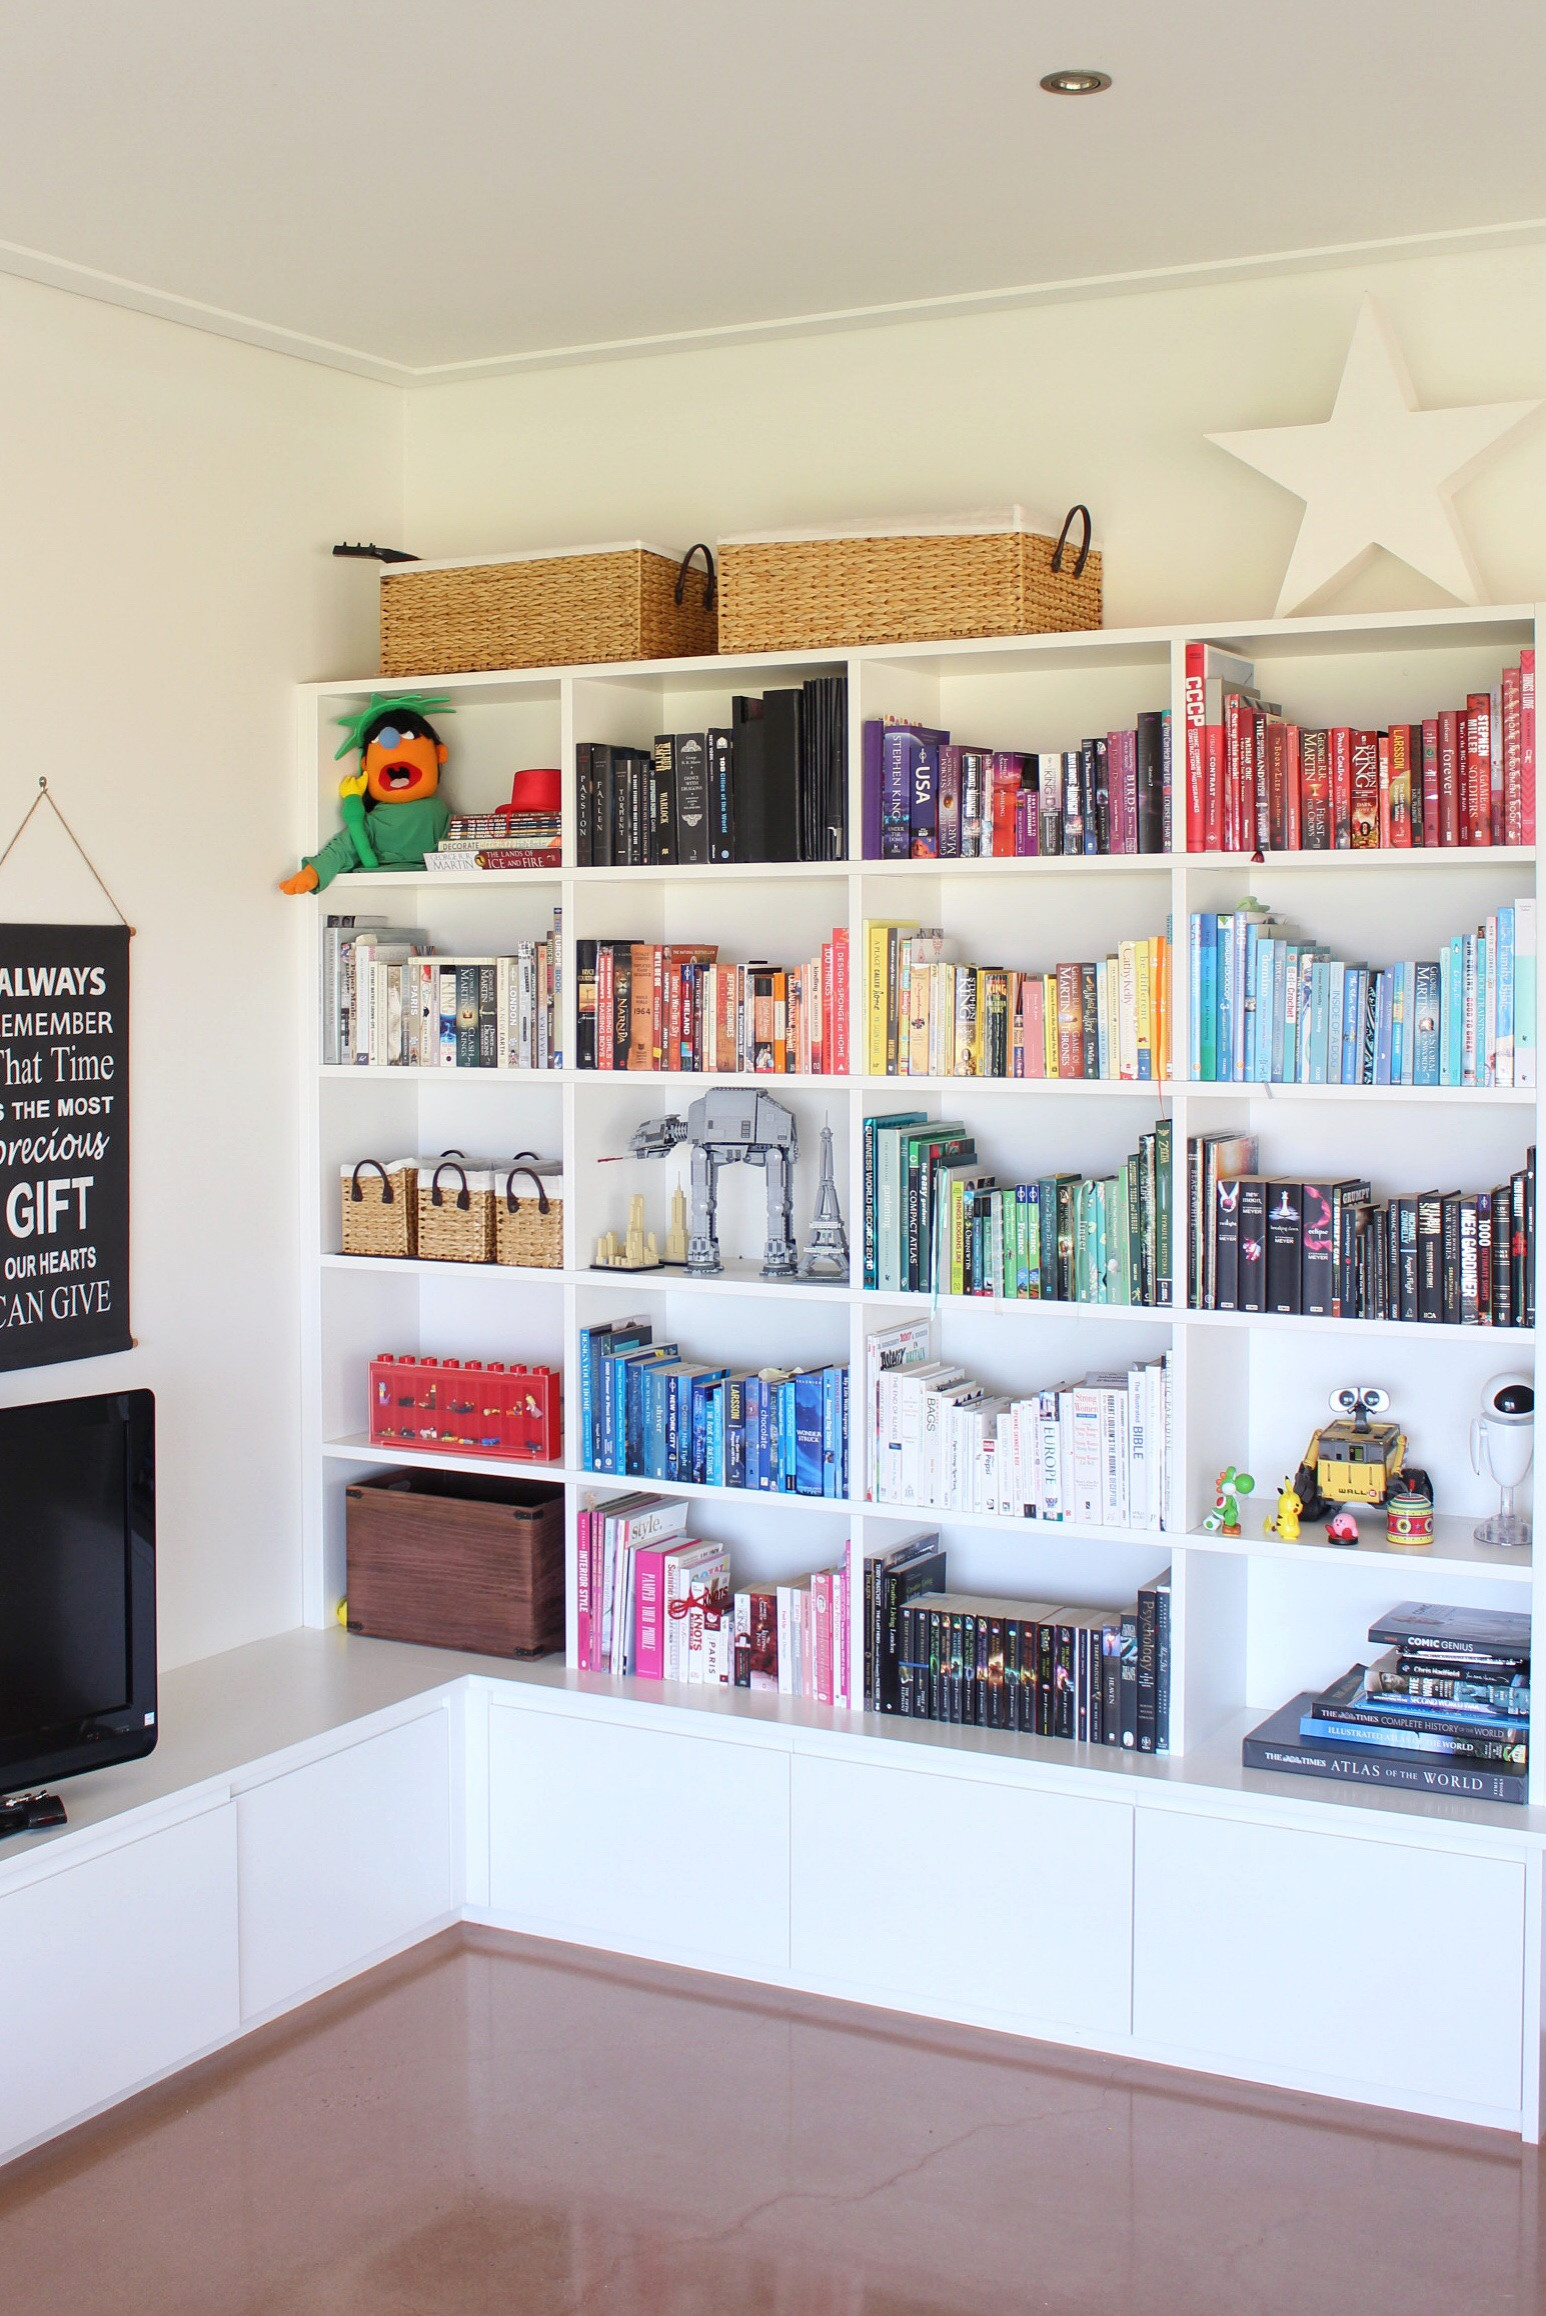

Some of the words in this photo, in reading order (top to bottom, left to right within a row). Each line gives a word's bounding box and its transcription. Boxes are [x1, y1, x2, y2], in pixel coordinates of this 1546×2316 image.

[1186, 676, 1204, 726] CCCP
[1231, 728, 1237, 738] up
[1318, 733, 1326, 763] GEORGE
[1393, 730, 1404, 769] LARSSON
[1468, 719, 1477, 754] MILLER
[1478, 715, 1489, 756] STEPHEN
[892, 735, 901, 785] STEPHEN
[1304, 734, 1316, 781] MARTIN
[1352, 746, 1369, 788] KING
[1368, 745, 1376, 787] STEPHEN
[1443, 749, 1454, 795] forever
[916, 766, 930, 804] USA
[1127, 775, 1135, 813] BIRDS
[1468, 765, 1478, 818] SOLDIERS
[580, 776, 588, 836] PASSION
[892, 790, 901, 819] KING
[1307, 812, 1315, 836] CROWS
[1316, 808, 1325, 836] FEAST
[443, 842, 479, 850] DECORATE
[488, 858, 505, 868] ICE
[523, 857, 544, 868] FIRE
[433, 860, 475, 870] MARTIN
[1122, 949, 1132, 979] Cathy
[0, 967, 106, 997] ALWAYS
[460, 969, 469, 1009] MARTIN
[960, 977, 970, 1019] KING
[1060, 967, 1071, 1012] MARTIN
[1123, 981, 1132, 1006] Kelly
[1417, 967, 1429, 1014] MARTIN
[1287, 987, 1296, 1018] Crochet
[1332, 990, 1341, 1019] INSIDE
[0, 1011, 113, 1037] EMEMBER
[616, 998, 627, 1044] NARNIA
[1332, 1022, 1340, 1035] OF
[663, 1040, 668, 1048] DO
[1061, 1025, 1071, 1066] THRONES
[1332, 1045, 1341, 1068] DOG
[51, 1045, 114, 1083] Time
[12, 1100, 50, 1120] THE
[57, 1096, 114, 1117] MOST
[865, 1126, 873, 1170] GUINNESS
[920, 1175, 928, 1196] easy
[6, 1176, 94, 1238] GIFT
[882, 1185, 892, 1228] gardening
[1462, 1209, 1476, 1236] MEG
[865, 1205, 873, 1245] RECORDS
[1018, 1223, 1026, 1255] France
[1308, 1229, 1329, 1239] eclipse
[1333, 1206, 1341, 1245] GRUMPY
[1401, 1210, 1409, 1243] CONNELLY
[1408, 1212, 1416, 1242] MICHAEL
[1479, 1219, 1491, 1246] 1000
[4, 1254, 37, 1280] OUR
[39, 1246, 97, 1275] HEARTS
[1405, 1256, 1413, 1276] Angels
[1462, 1243, 1477, 1298] GARDINER
[50, 1280, 112, 1320] GIVE
[1405, 1277, 1414, 1294] Flight
[730, 1384, 739, 1419] LARSSON
[927, 1398, 935, 1431] BAGS
[760, 1410, 769, 1449] chocolate
[1133, 1426, 1143, 1459] BIBLE
[1043, 1427, 1056, 1485] EUROPE
[579, 1550, 588, 1587] INTERIOR
[579, 1589, 588, 1613] STYLE
[889, 1579, 897, 1605] Creative
[693, 1613, 702, 1651] KNOTS
[889, 1607, 897, 1627] Living
[1140, 1601, 1154, 1671] Psychology
[1407, 1637, 1440, 1648] COMIC
[1441, 1640, 1474, 1652] GENIUS
[708, 1641, 716, 1674] PARIS
[1414, 1666, 1432, 1675] Chris
[1432, 1668, 1460, 1678] Hadfield
[1321, 1710, 1337, 1718] THE
[1355, 1713, 1379, 1723] TIMES
[1381, 1716, 1424, 1729] COMPLETE
[1425, 1721, 1459, 1733] HISTORY
[1474, 1727, 1504, 1738] WORLD
[1328, 1727, 1383, 1740] ILLUSTRATED
[1442, 1740, 1474, 1751] WORLD
[1265, 1752, 1283, 1762] THE
[1301, 1757, 1326, 1767] TIMES
[1331, 1760, 1380, 1777] ATLAS
[1386, 1769, 1398, 1778] OF
[1400, 1771, 1418, 1780] THE
[1424, 1771, 1483, 1790] WORLD
